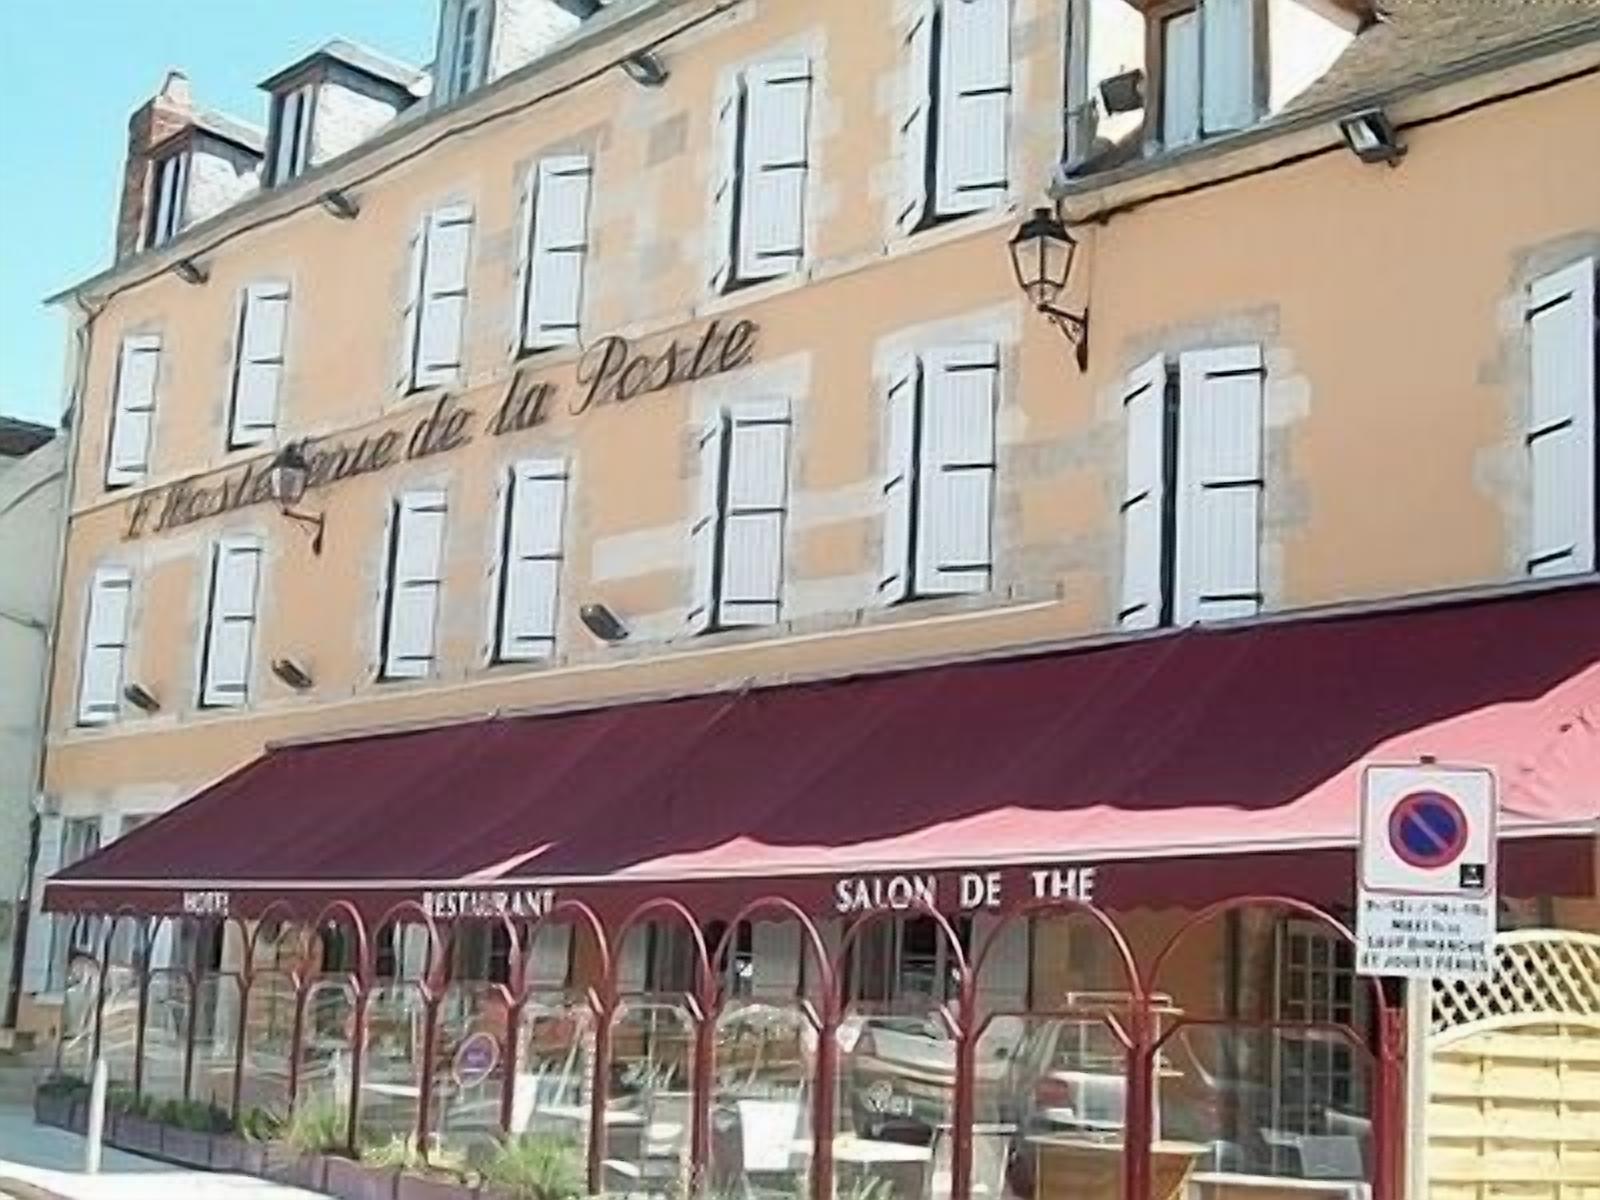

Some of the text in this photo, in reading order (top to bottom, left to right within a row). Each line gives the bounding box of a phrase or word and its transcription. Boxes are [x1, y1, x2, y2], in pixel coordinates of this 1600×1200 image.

[406, 391, 475, 461] de
[485, 366, 557, 436] la
[568, 319, 760, 416] Poste
[422, 890, 555, 917] RESTAURANT
[836, 874, 937, 913] SALON
[960, 872, 1001, 908] DE
